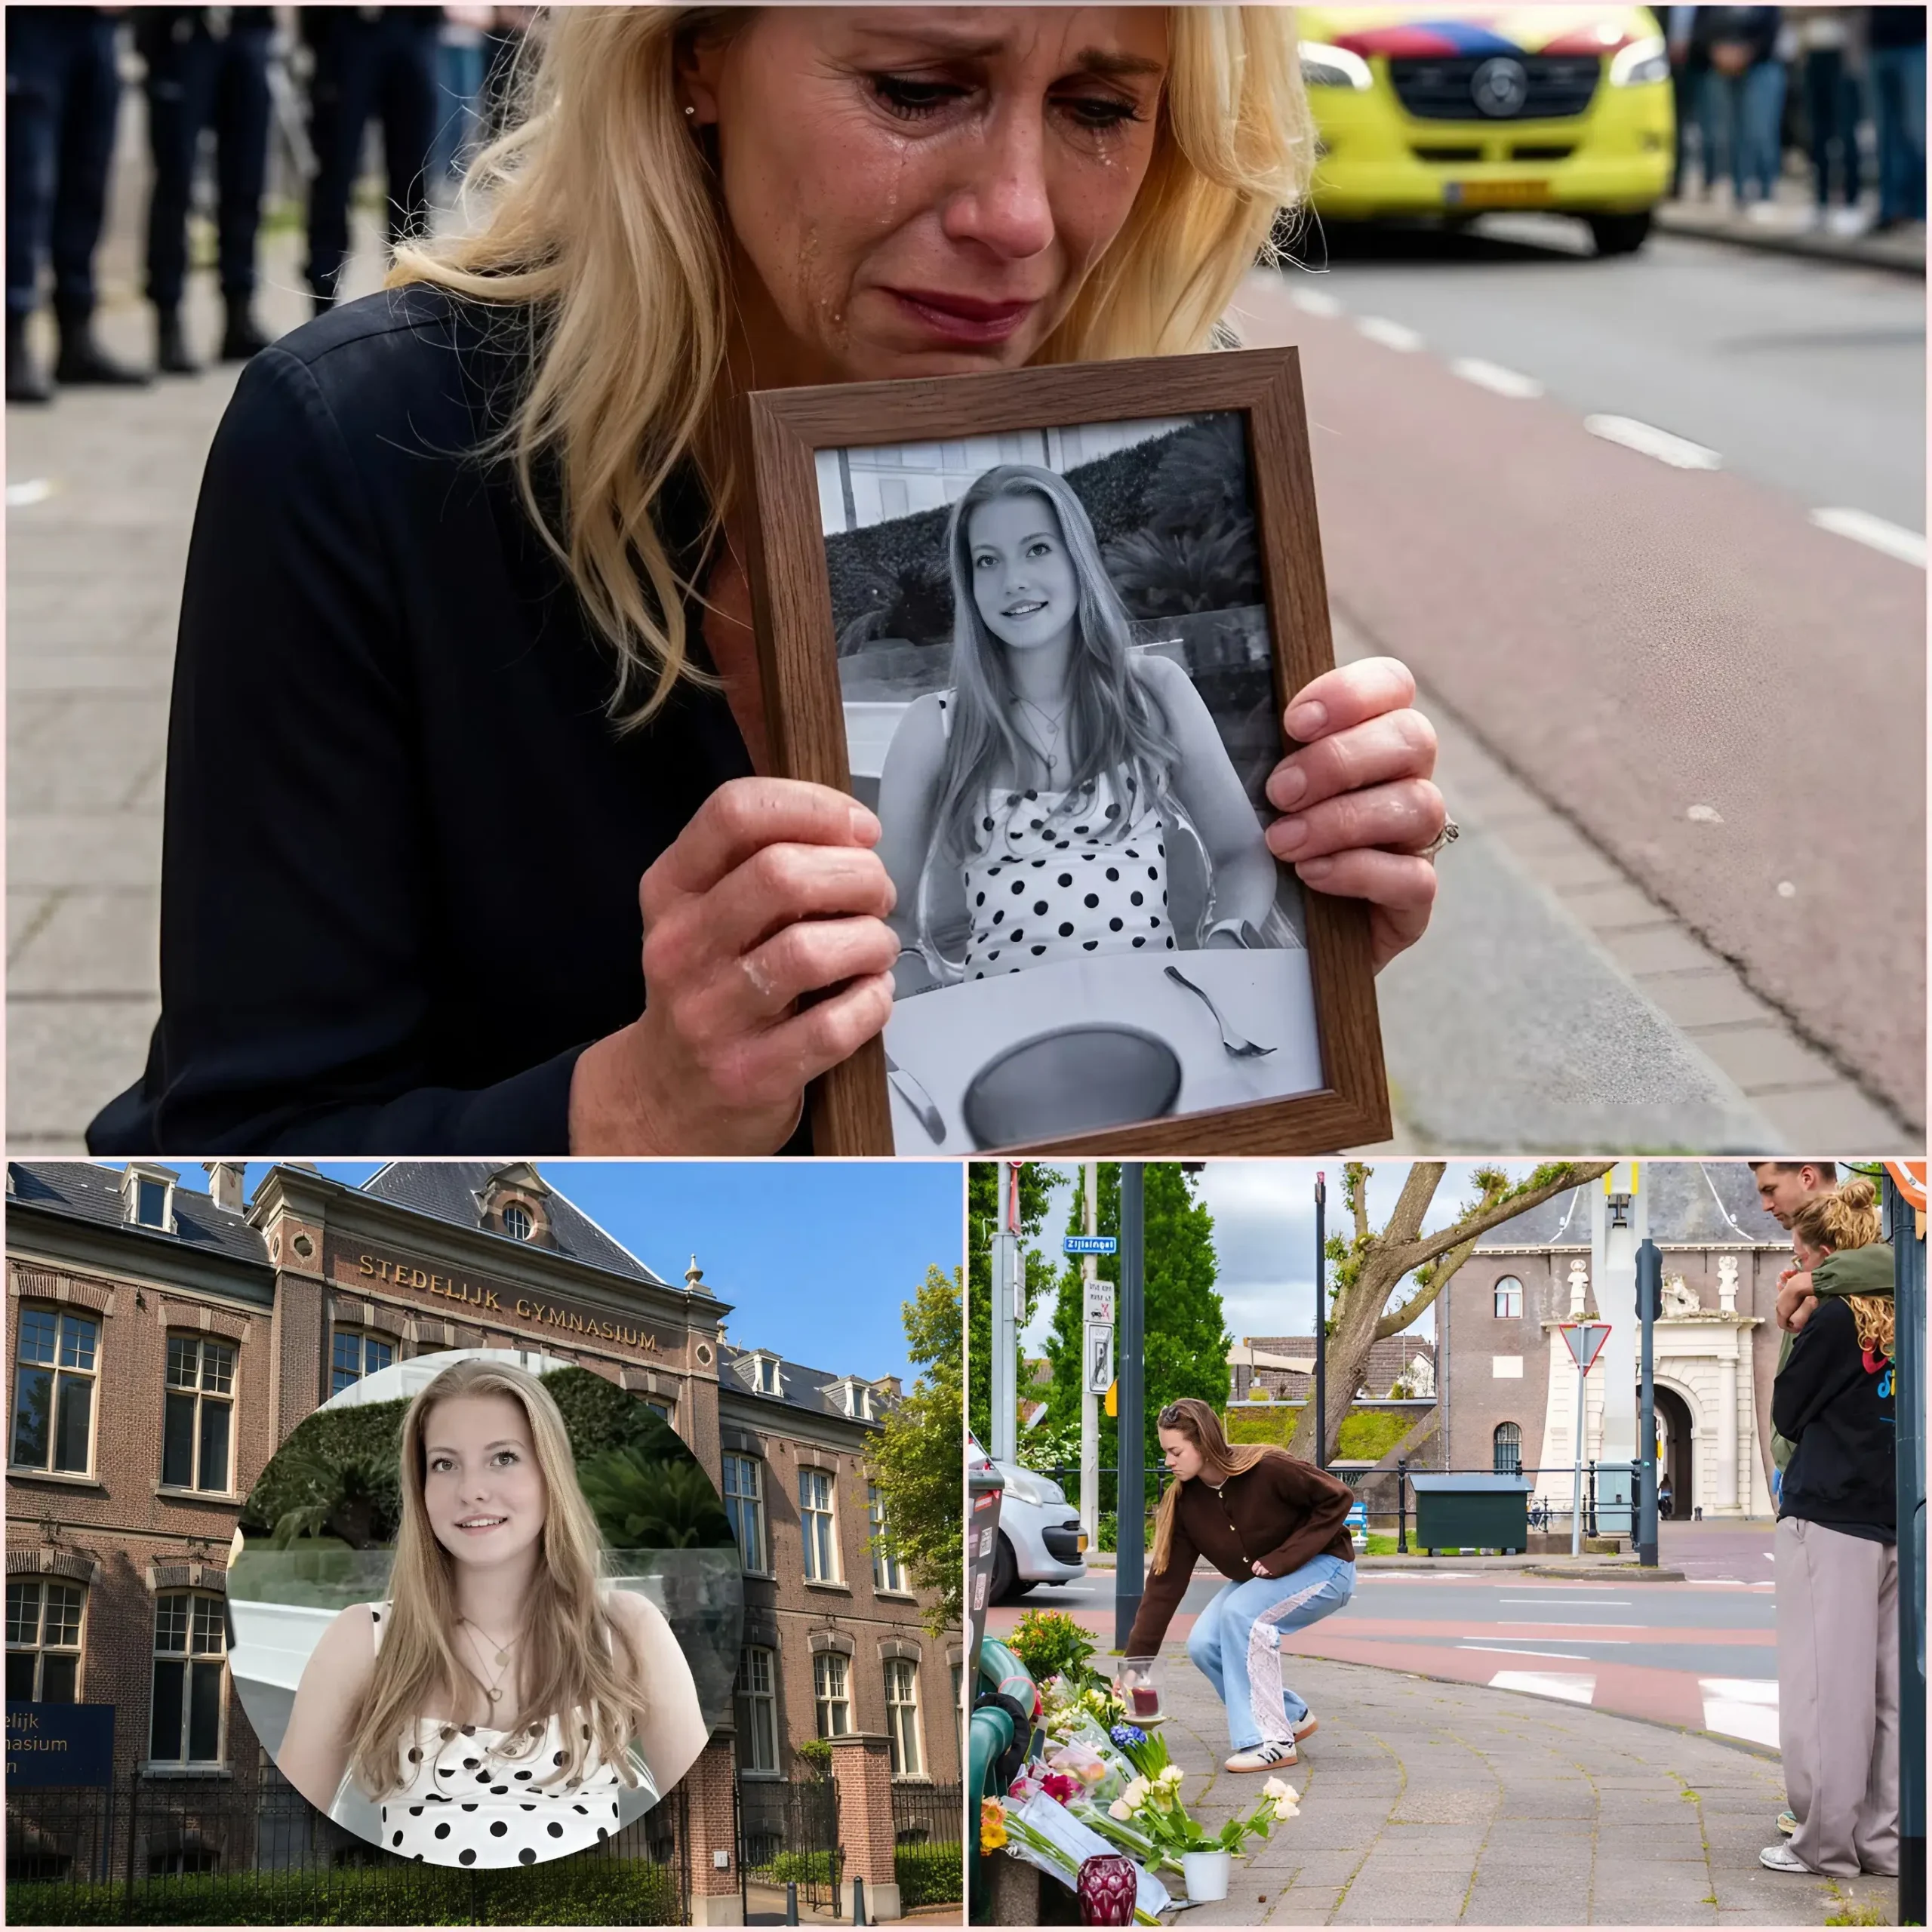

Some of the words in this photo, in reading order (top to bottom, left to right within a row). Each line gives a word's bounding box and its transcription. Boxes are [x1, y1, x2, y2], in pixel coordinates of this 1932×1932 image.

[1068, 1240, 1113, 1250] Zijlsingel
[359, 1255, 501, 1309] STEDELIJK
[516, 1299, 657, 1352] GYMNASIUM
